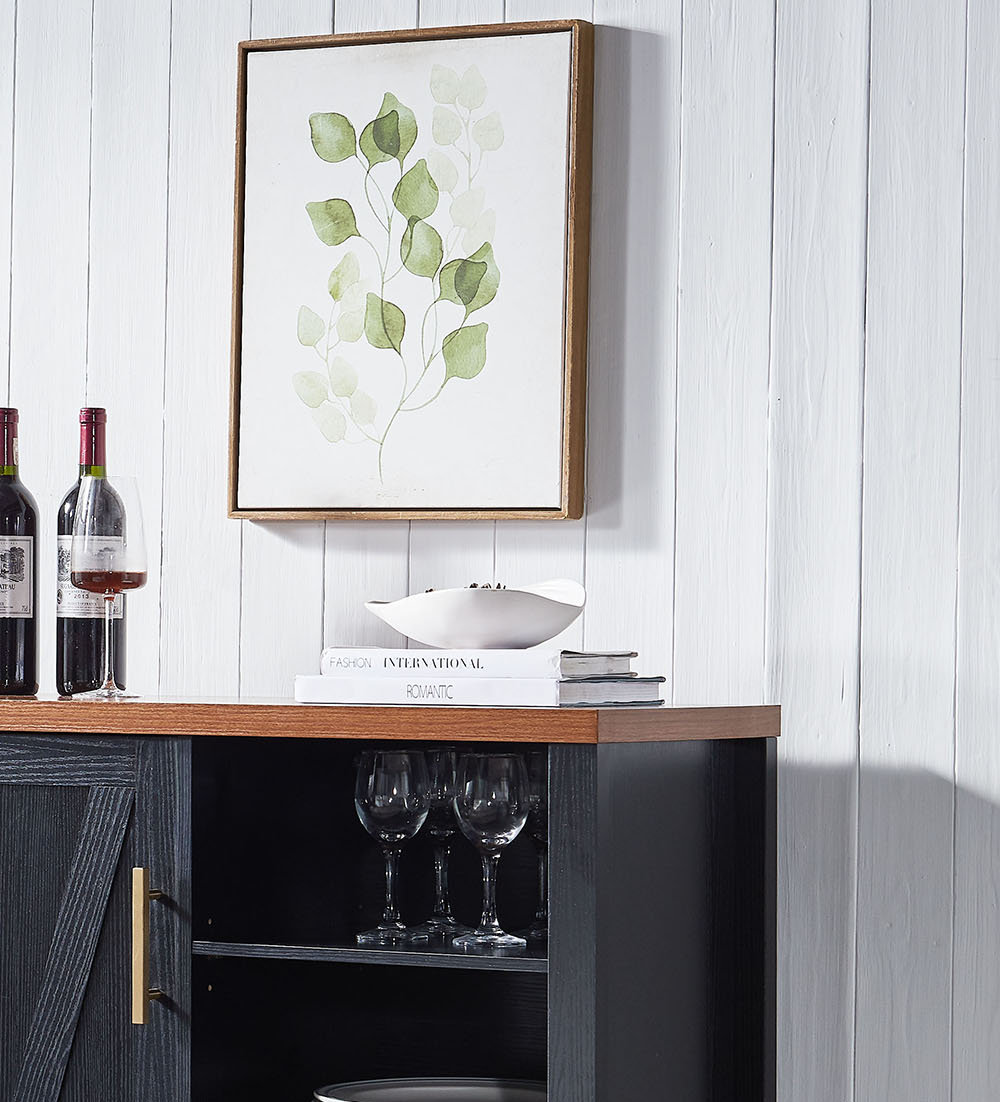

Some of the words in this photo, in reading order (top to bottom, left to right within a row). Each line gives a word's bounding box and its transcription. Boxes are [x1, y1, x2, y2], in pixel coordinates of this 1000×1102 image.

[329, 656, 372, 669] FASHION
[383, 657, 484, 669] INTERNATIONAL
[406, 683, 454, 700] ROMANTIC
